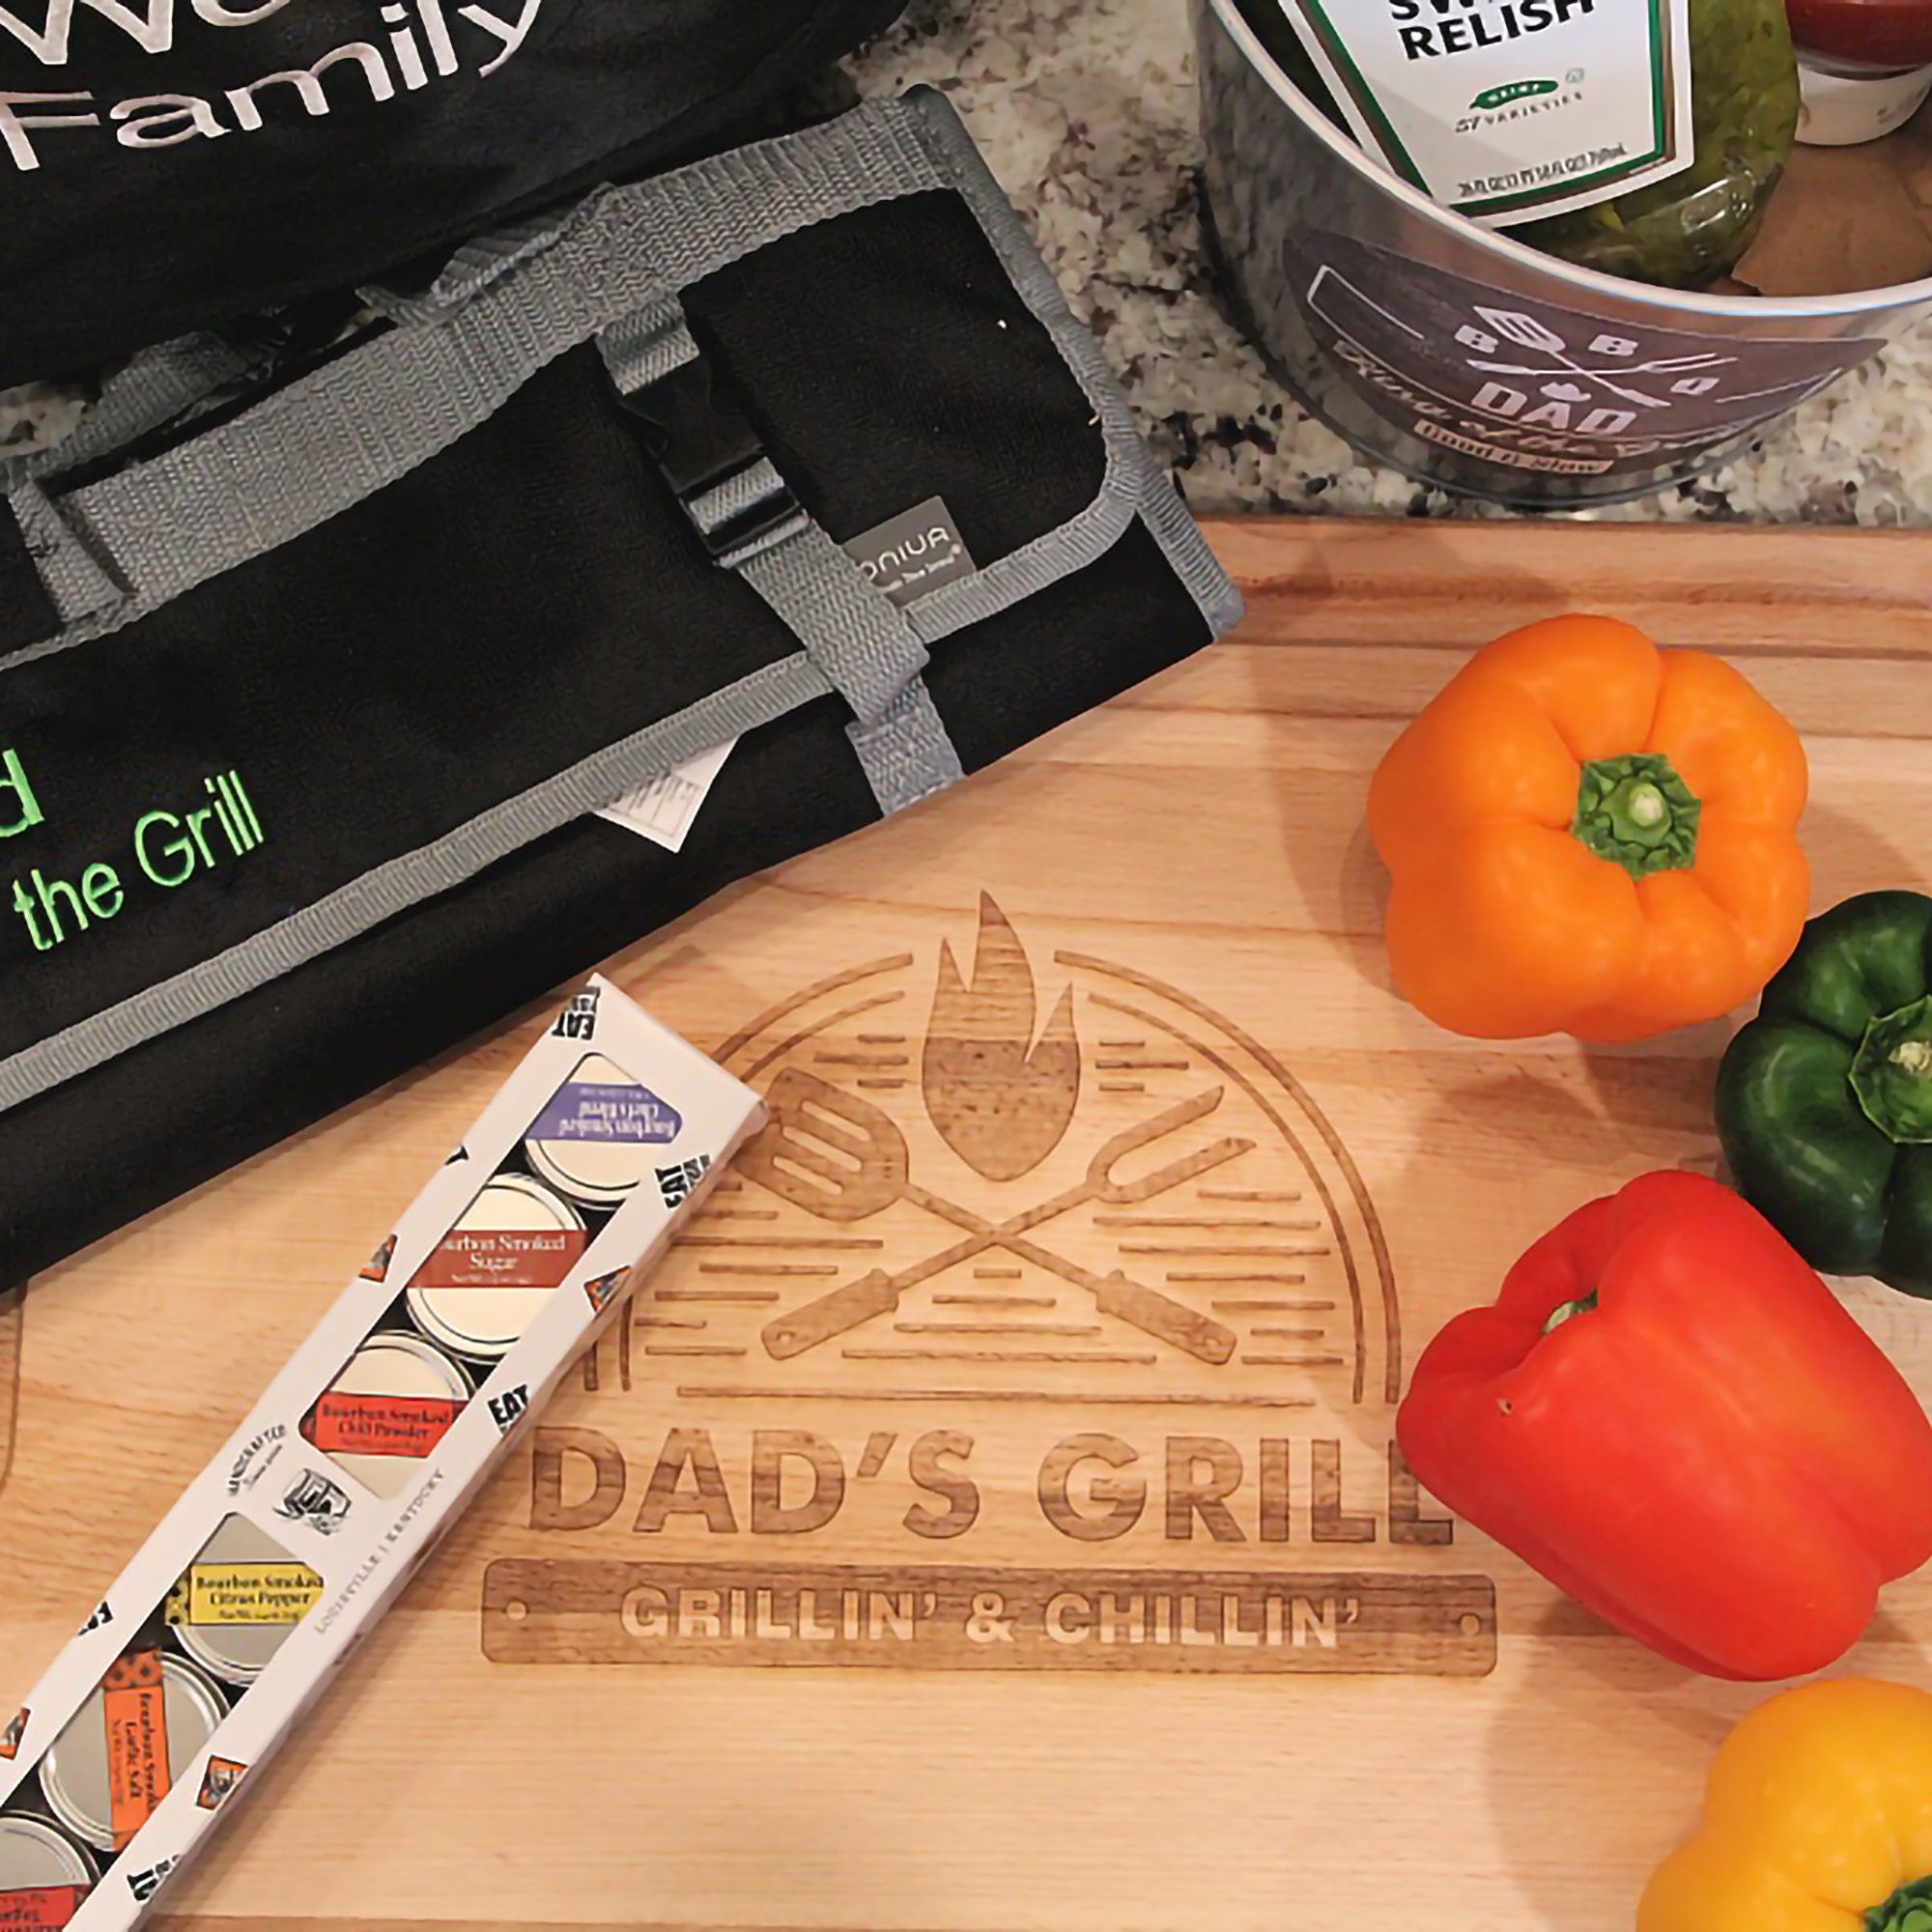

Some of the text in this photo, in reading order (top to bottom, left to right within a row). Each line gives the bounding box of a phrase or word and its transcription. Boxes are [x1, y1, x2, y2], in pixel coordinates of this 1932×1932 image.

[1398, 0, 1594, 61] RELISH
[0, 0, 542, 171] Family
[1471, 382, 1637, 436] DAD
[13, 770, 264, 951] the Grill
[529, 1426, 1454, 1546] DAD'S GRILL
[619, 1585, 1360, 1648] GRILLIN' & CHILLIN'
